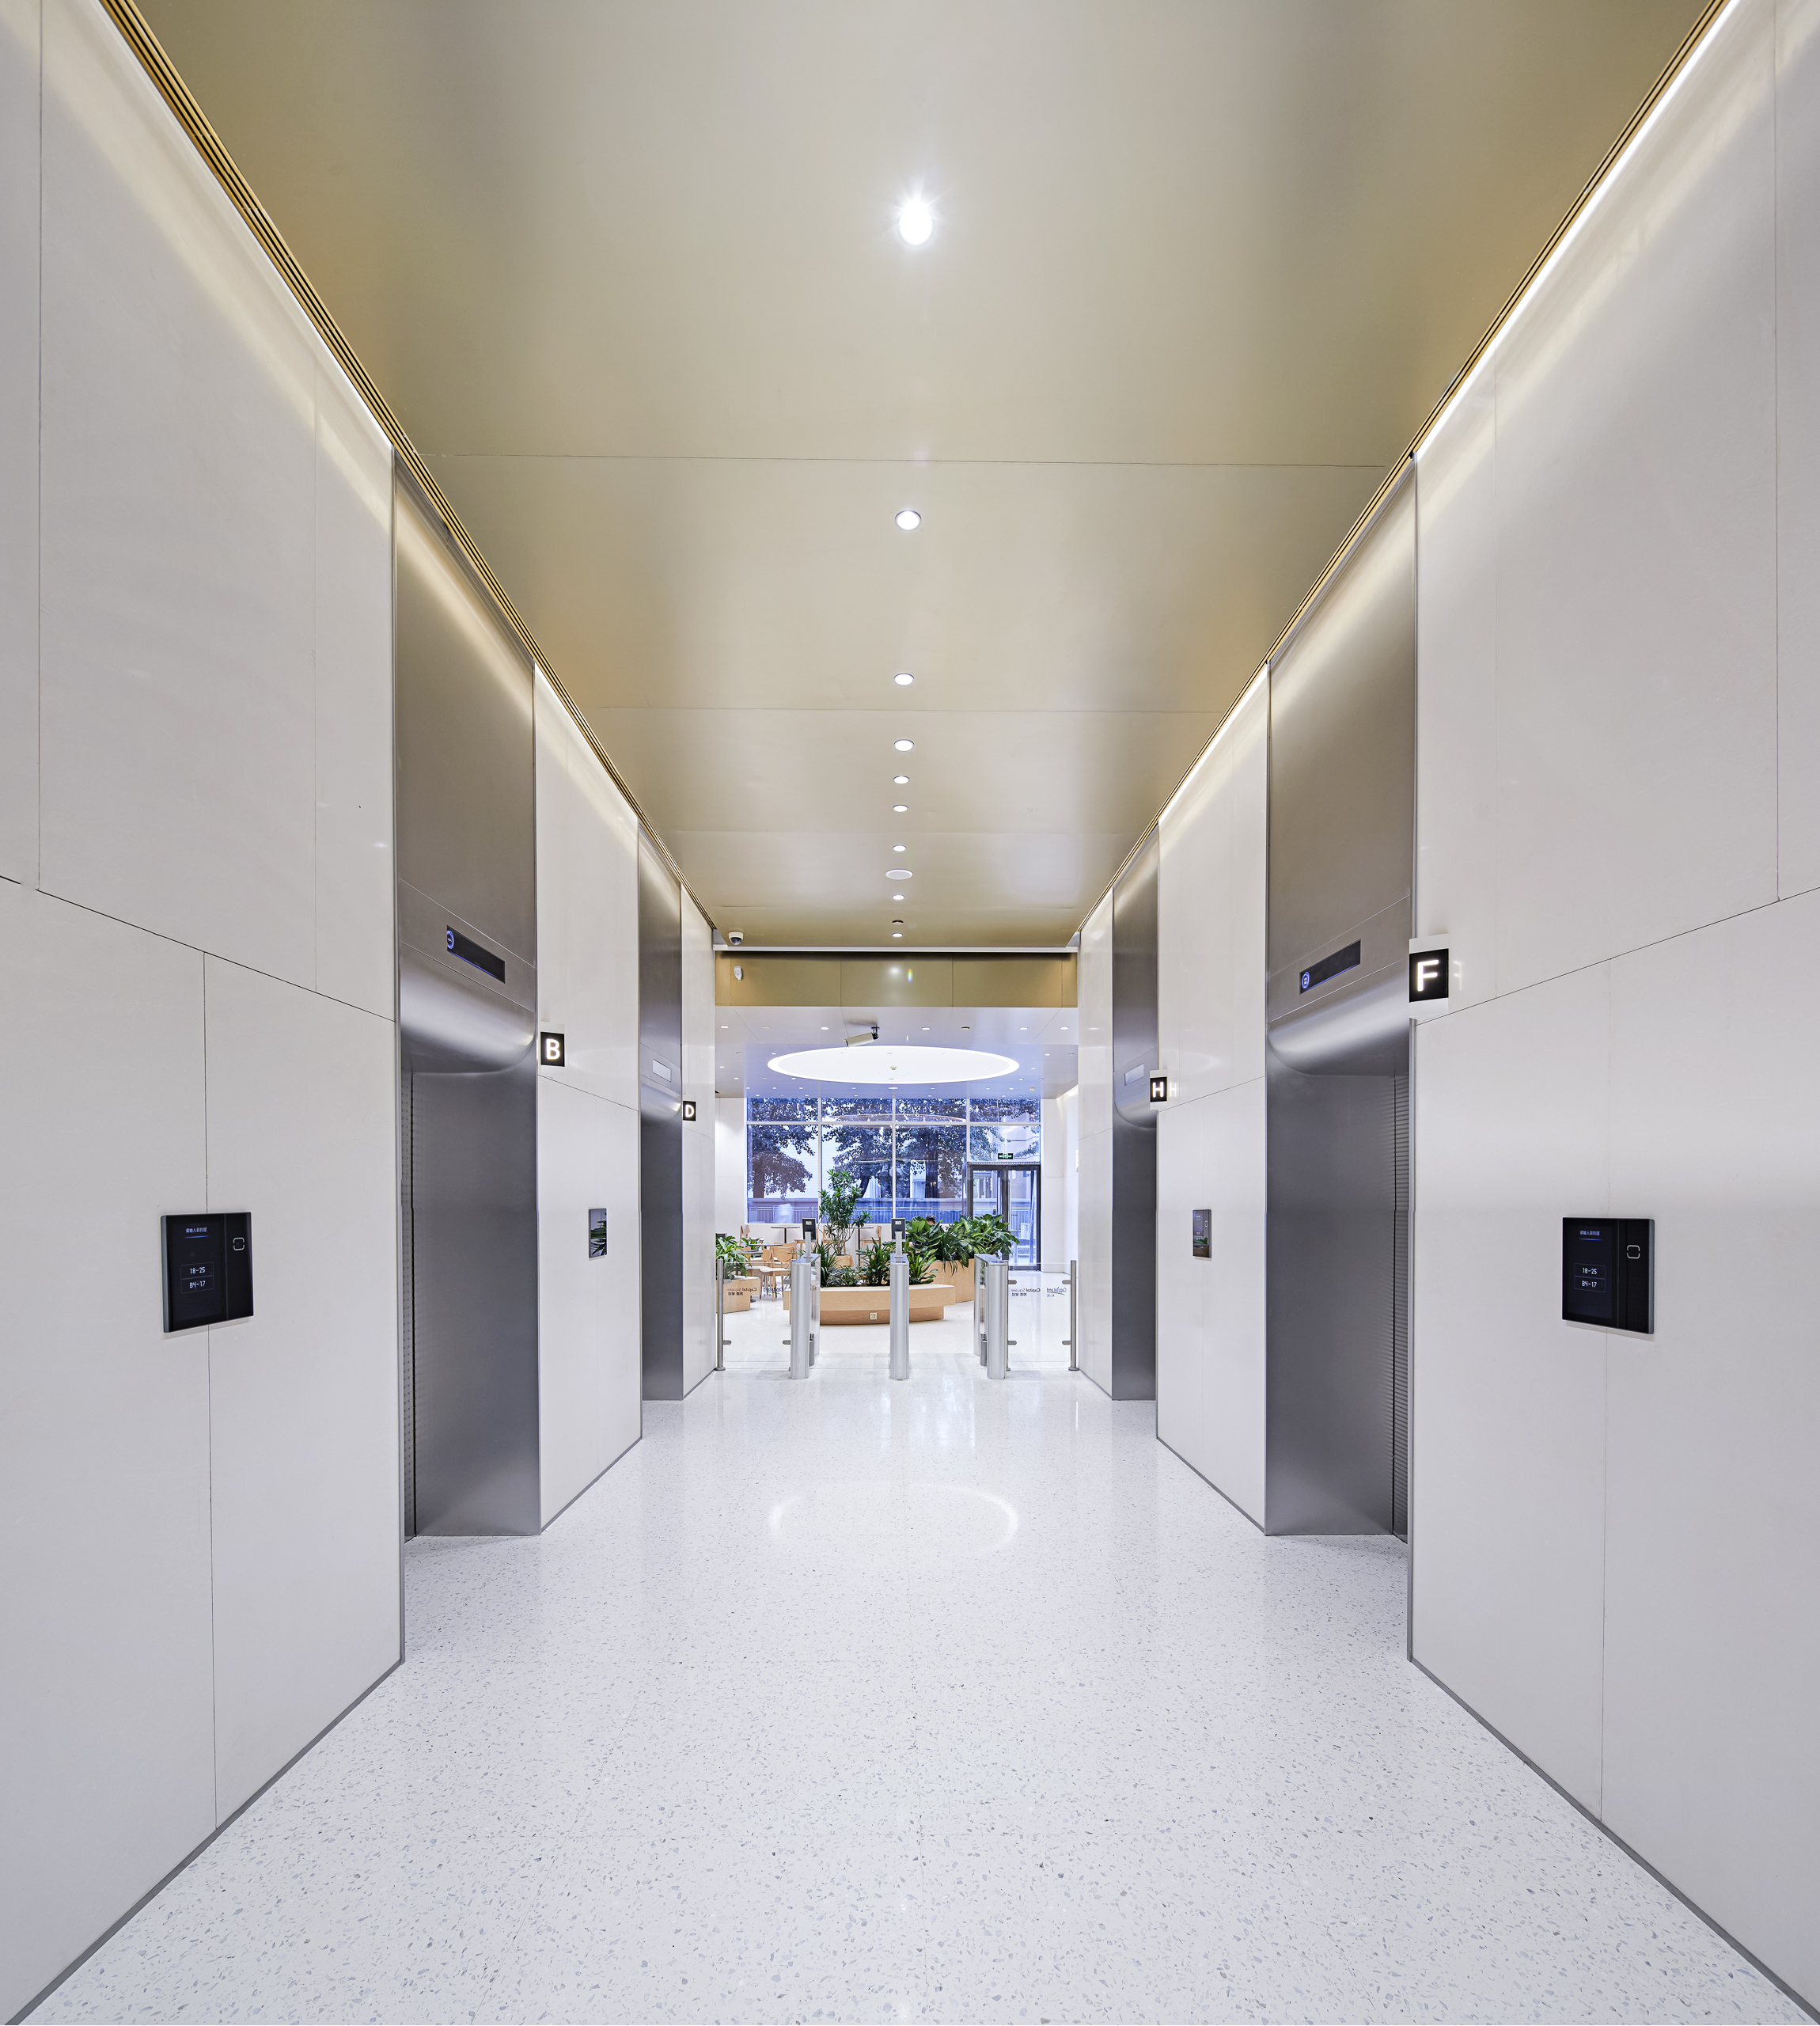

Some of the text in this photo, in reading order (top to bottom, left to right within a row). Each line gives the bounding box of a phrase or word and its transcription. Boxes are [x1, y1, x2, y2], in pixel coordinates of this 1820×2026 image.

[1417, 959, 1439, 992] F
[546, 1038, 560, 1060] B
[1152, 1081, 1164, 1098] H
[685, 1104, 695, 1117] D
